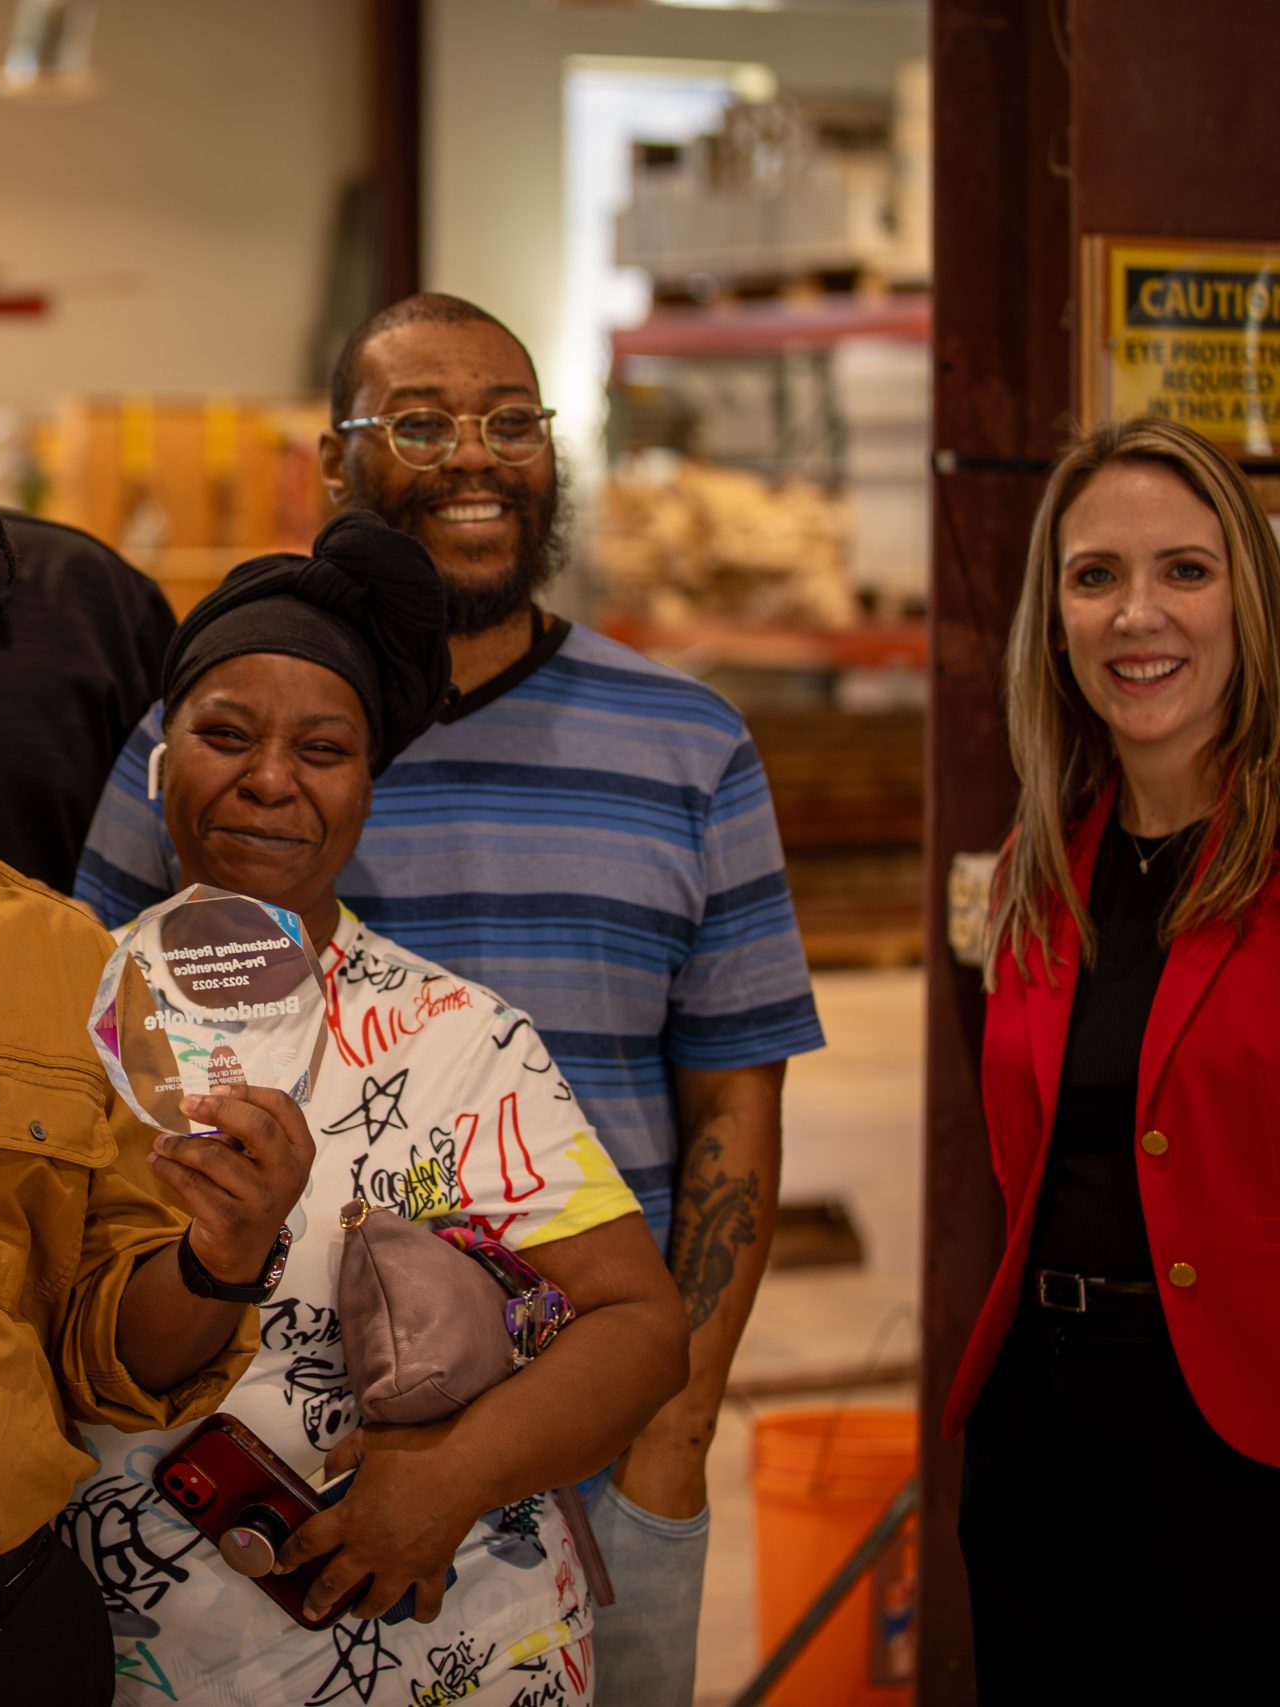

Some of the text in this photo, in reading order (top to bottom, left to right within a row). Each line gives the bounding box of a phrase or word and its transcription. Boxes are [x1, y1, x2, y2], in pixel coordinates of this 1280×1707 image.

[1139, 277, 1280, 321] CAUTIO
[1127, 338, 1164, 362] EYE
[1162, 369, 1274, 395] REQUIRED
[1178, 400, 1225, 420] THIS
